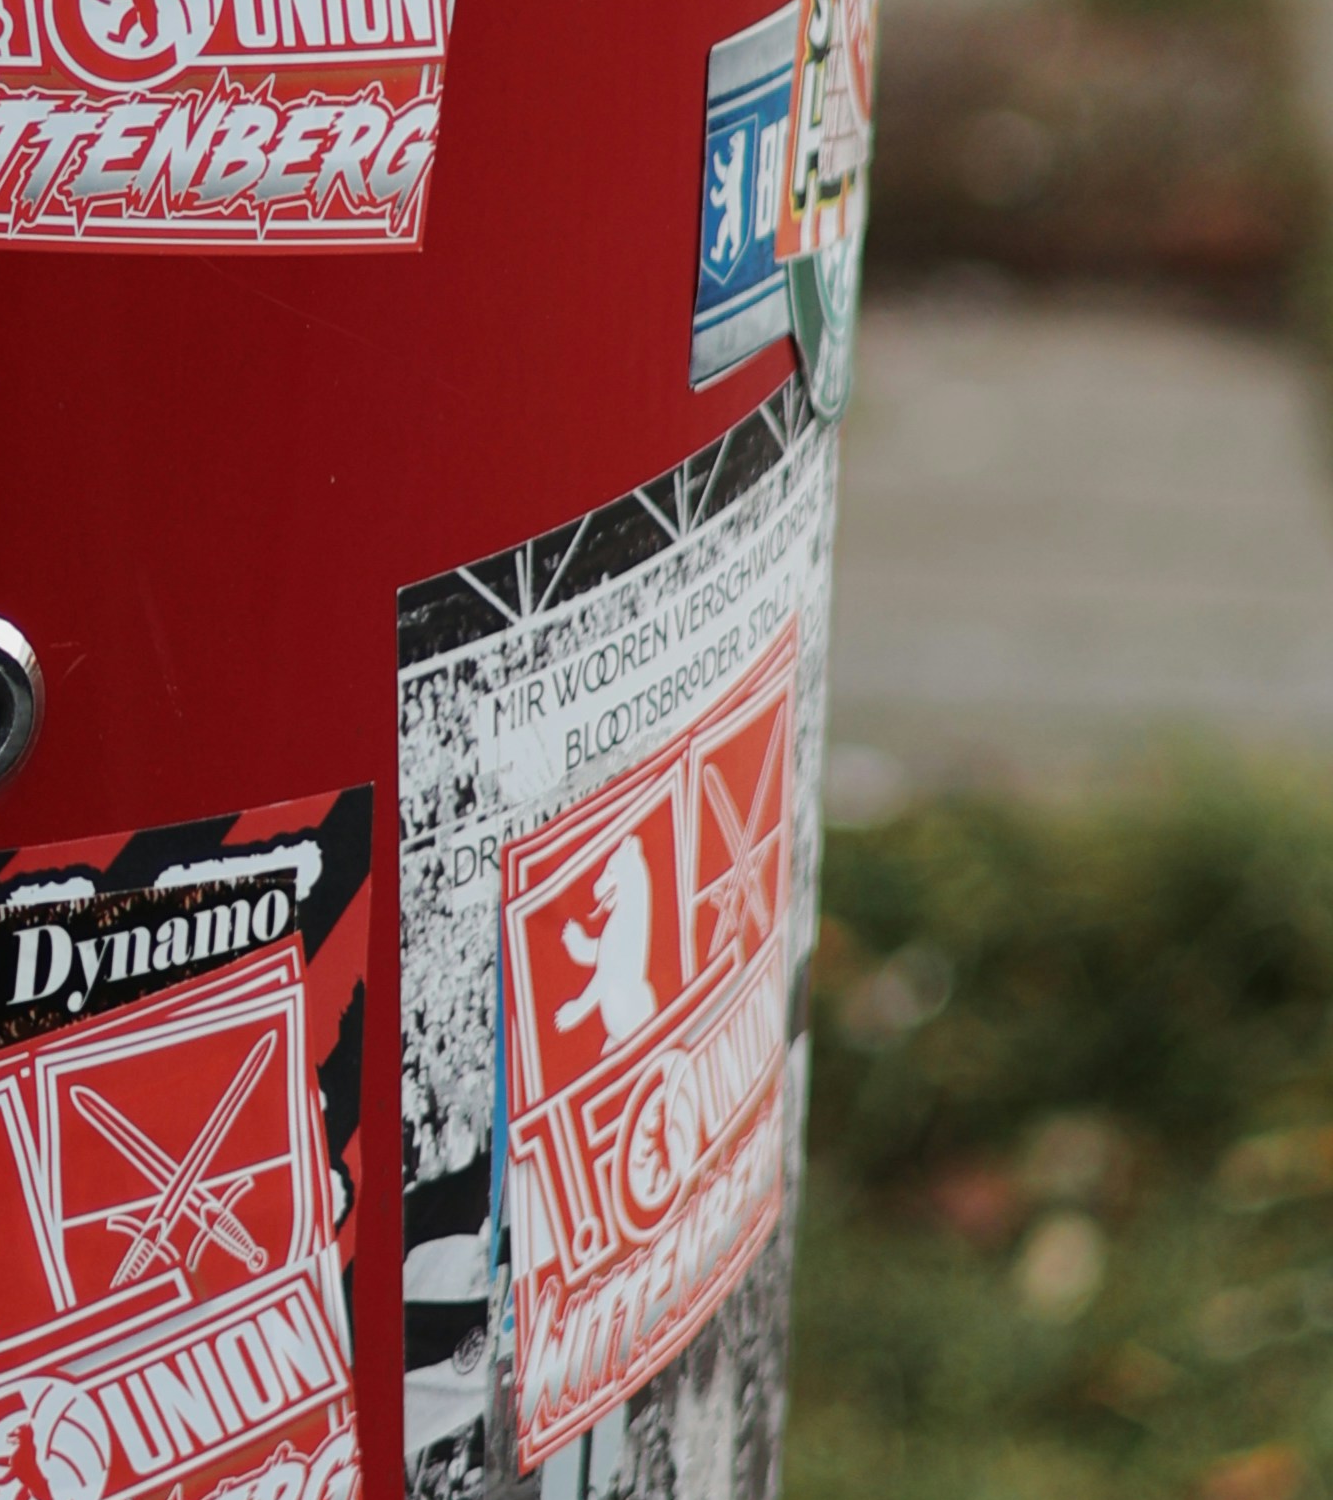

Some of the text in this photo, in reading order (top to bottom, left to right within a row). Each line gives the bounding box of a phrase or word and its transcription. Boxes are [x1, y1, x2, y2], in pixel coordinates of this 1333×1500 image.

[492, 678, 547, 738] MIR
[7, 887, 291, 1014] Dynamo
[105, 1297, 336, 1474] UNION
